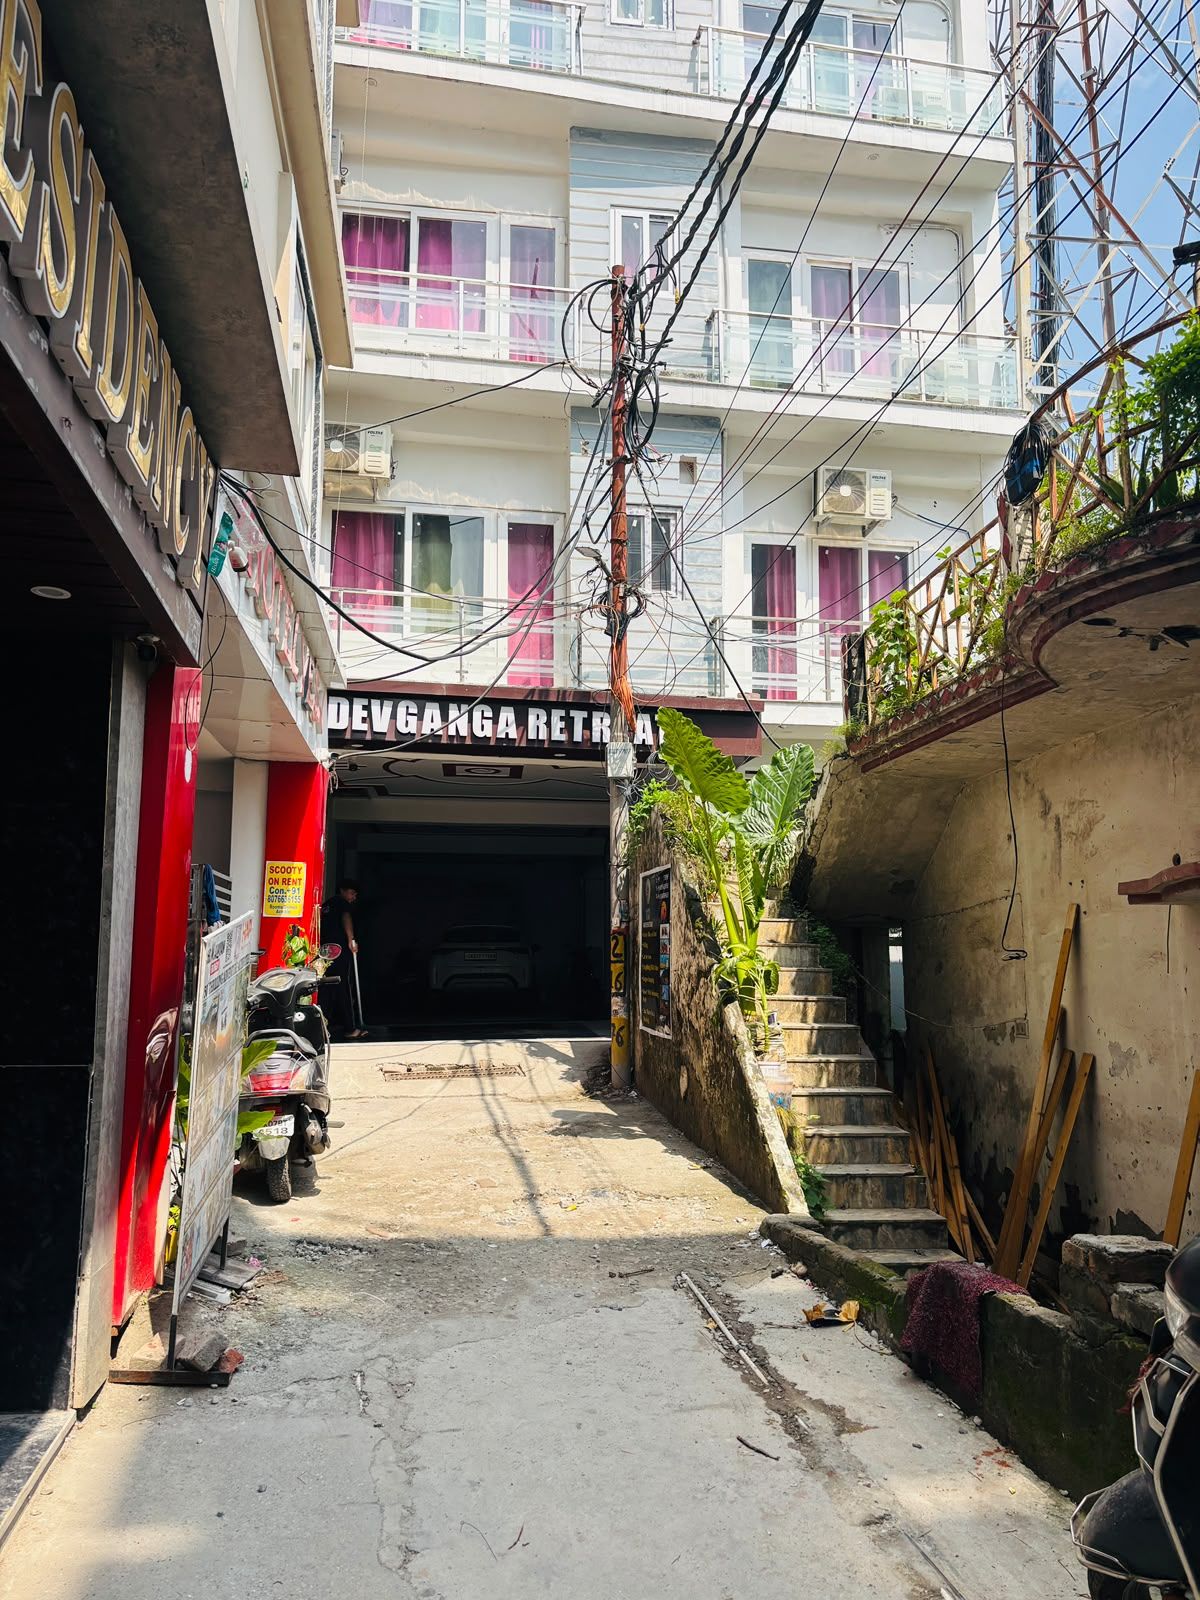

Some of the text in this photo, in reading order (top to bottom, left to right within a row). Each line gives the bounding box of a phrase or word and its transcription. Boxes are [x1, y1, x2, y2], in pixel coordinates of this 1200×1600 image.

[328, 696, 665, 746] DEVGANGA RETRA
[269, 866, 302, 874] SCOOTY
[282, 878, 302, 886] RENT
[611, 935, 623, 959] 2
